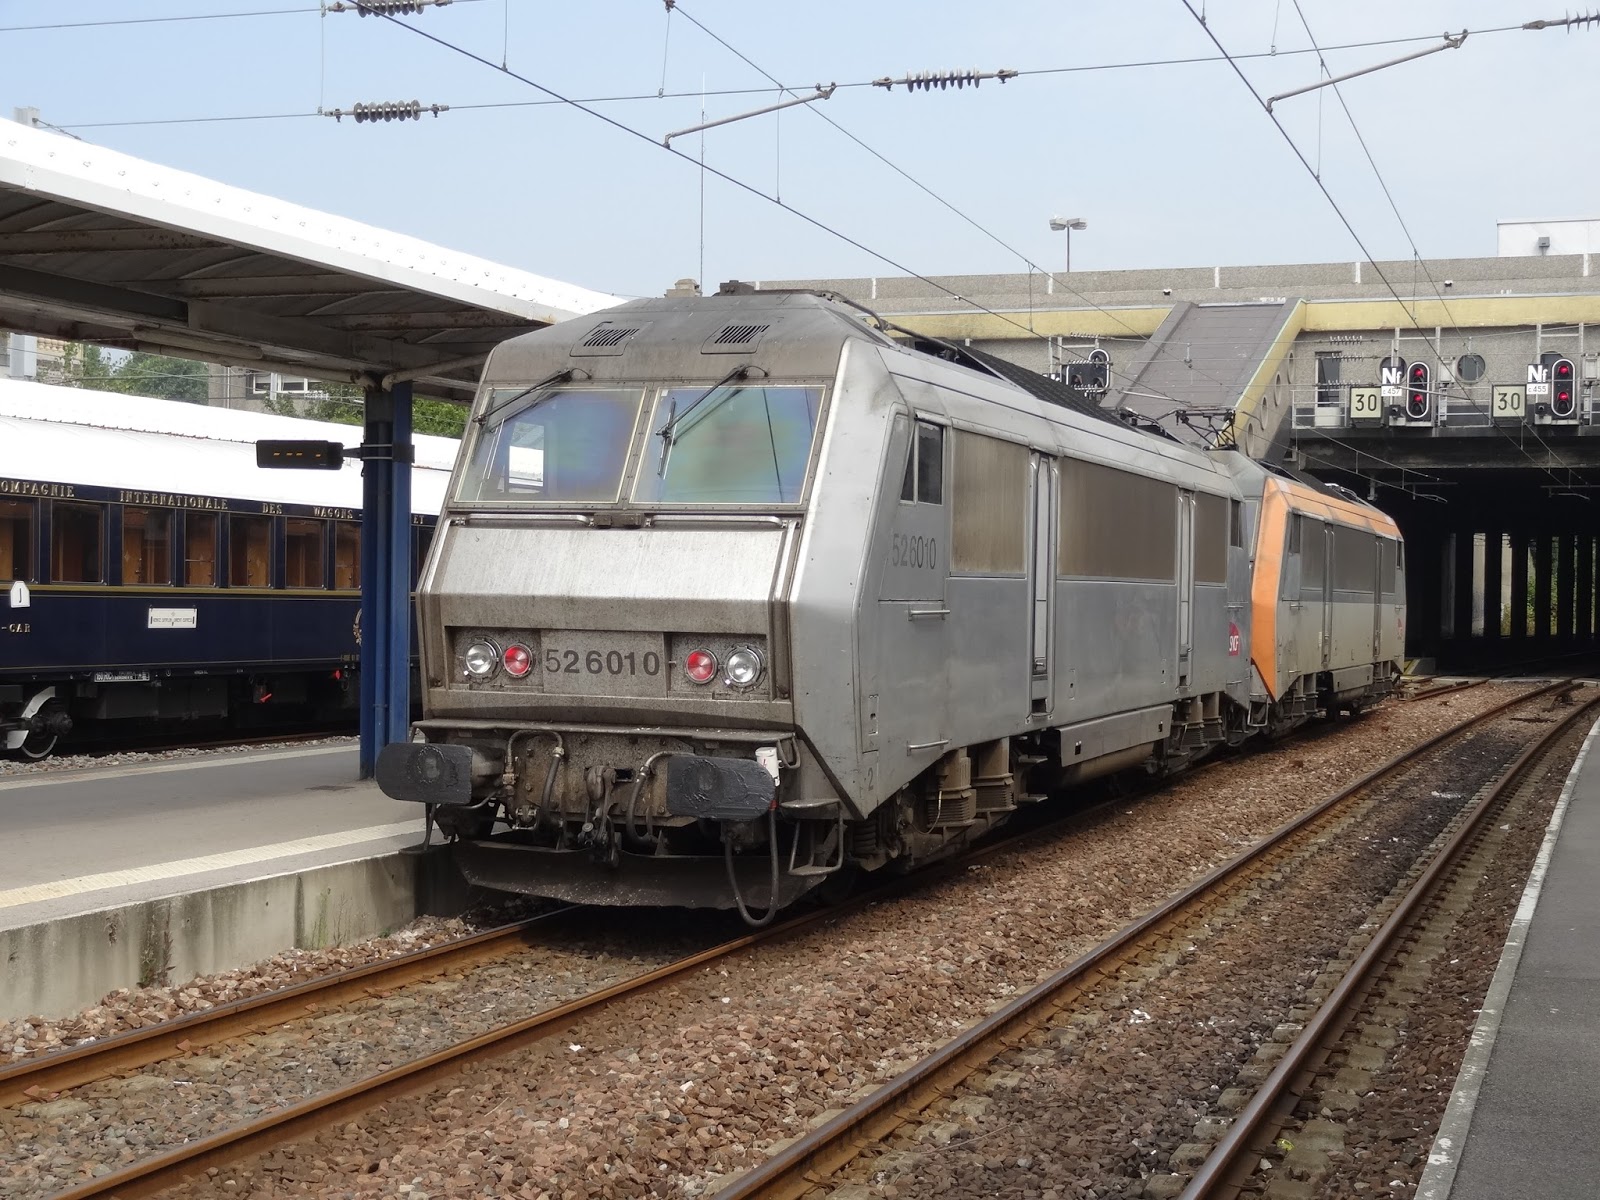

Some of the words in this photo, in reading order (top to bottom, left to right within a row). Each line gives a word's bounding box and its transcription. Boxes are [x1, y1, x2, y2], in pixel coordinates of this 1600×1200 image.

[1382, 367, 1402, 384] Nf
[1527, 364, 1548, 383] Nf
[1355, 394, 1377, 412] 30
[1497, 392, 1520, 411] 30
[119, 490, 228, 510] INTERNATIONALE
[262, 502, 283, 515] DES
[413, 514, 424, 525] ET
[891, 533, 937, 570] 526010
[545, 649, 660, 676] 526010
